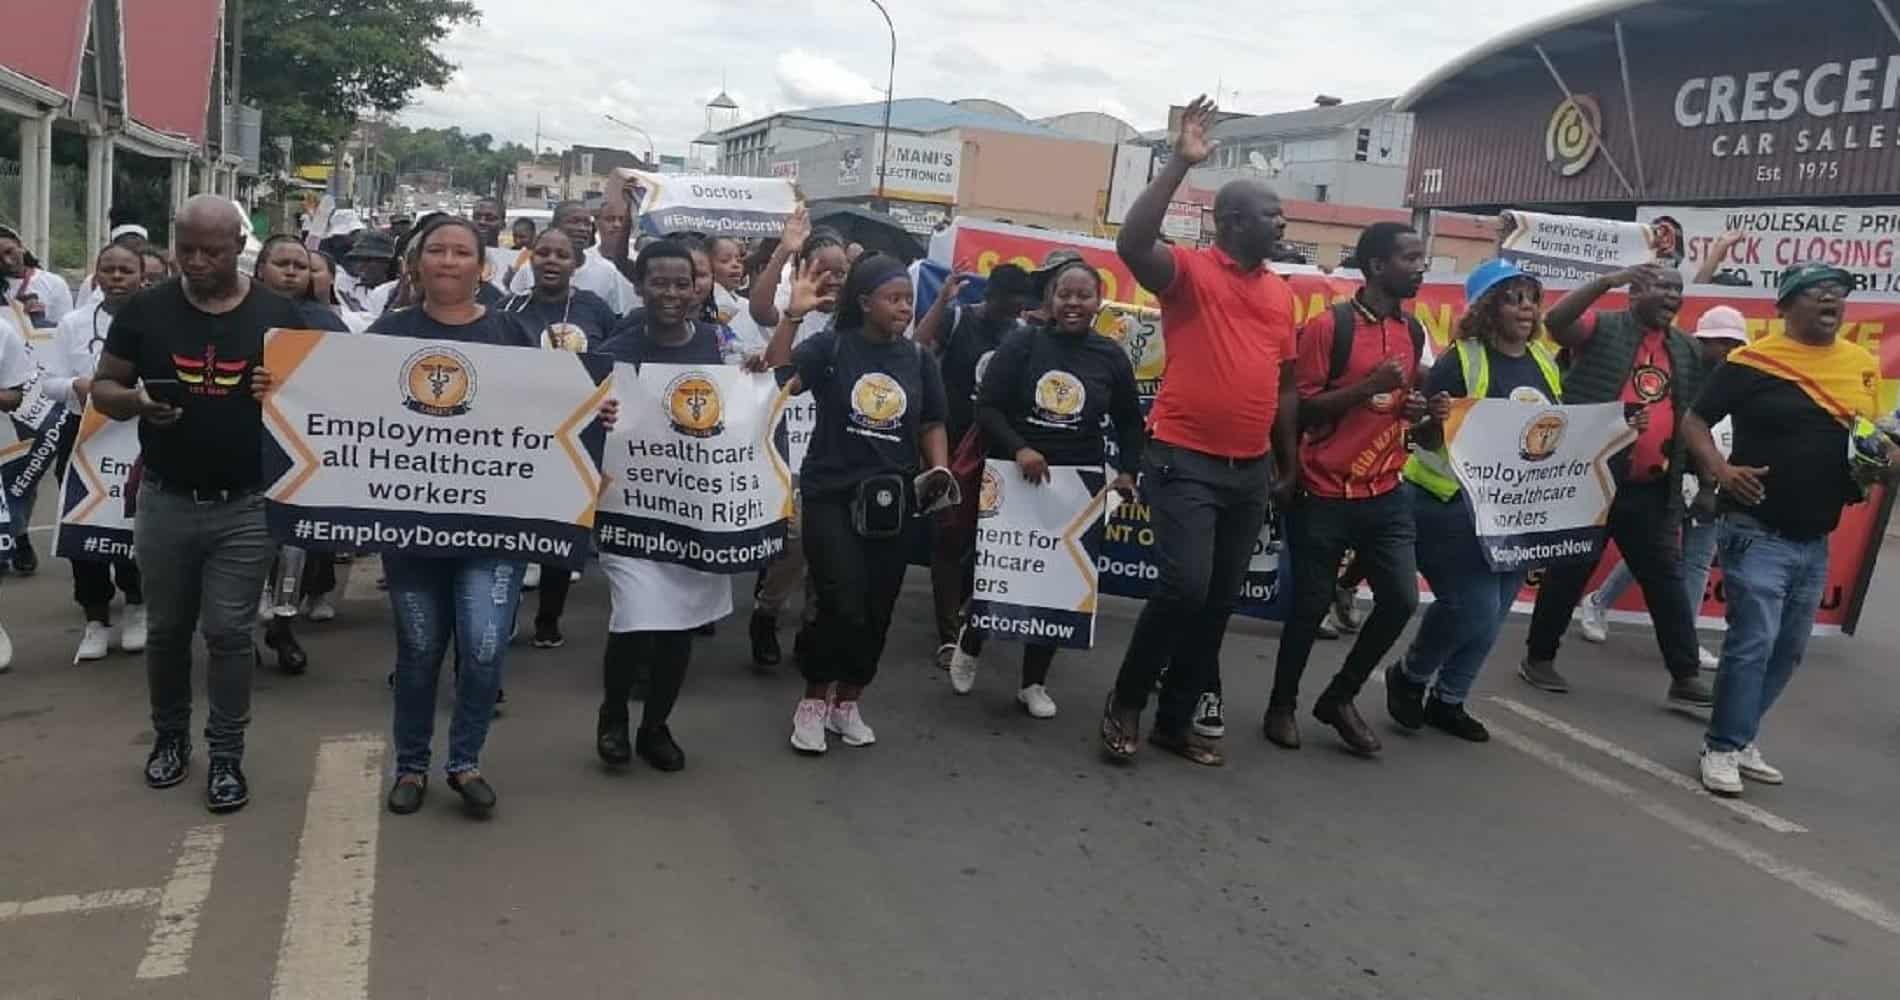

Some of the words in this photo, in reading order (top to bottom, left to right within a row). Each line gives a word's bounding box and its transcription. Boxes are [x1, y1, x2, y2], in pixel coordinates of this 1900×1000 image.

[1712, 132, 1774, 156] CAR
[1796, 125, 1900, 152] SALE
[1799, 161, 1839, 179] 1975
[691, 184, 753, 200] Doctors
[663, 213, 785, 234] #EmployDoctorsN
[1537, 221, 1595, 240] services
[1726, 213, 1847, 233] WHOLESALE
[1859, 214, 1900, 233] PRI
[1531, 237, 1580, 255] Human
[1583, 243, 1619, 263] Right
[1688, 236, 1761, 264] STCK
[1775, 236, 1894, 269] CLOSING
[1516, 258, 1601, 281] #EmployDoct
[306, 413, 502, 448] Employment
[511, 427, 555, 450] for
[322, 445, 359, 468] all
[368, 448, 535, 478] Healthcare
[1568, 459, 1592, 477] for
[368, 481, 487, 505] workers
[626, 467, 723, 494] services
[730, 471, 747, 492] is
[624, 488, 703, 520] Human
[712, 499, 764, 526] Right
[295, 519, 573, 558] #EmployDoctorsNow
[599, 524, 784, 564] #EmployDoctorsNow
[1029, 530, 1061, 551] for
